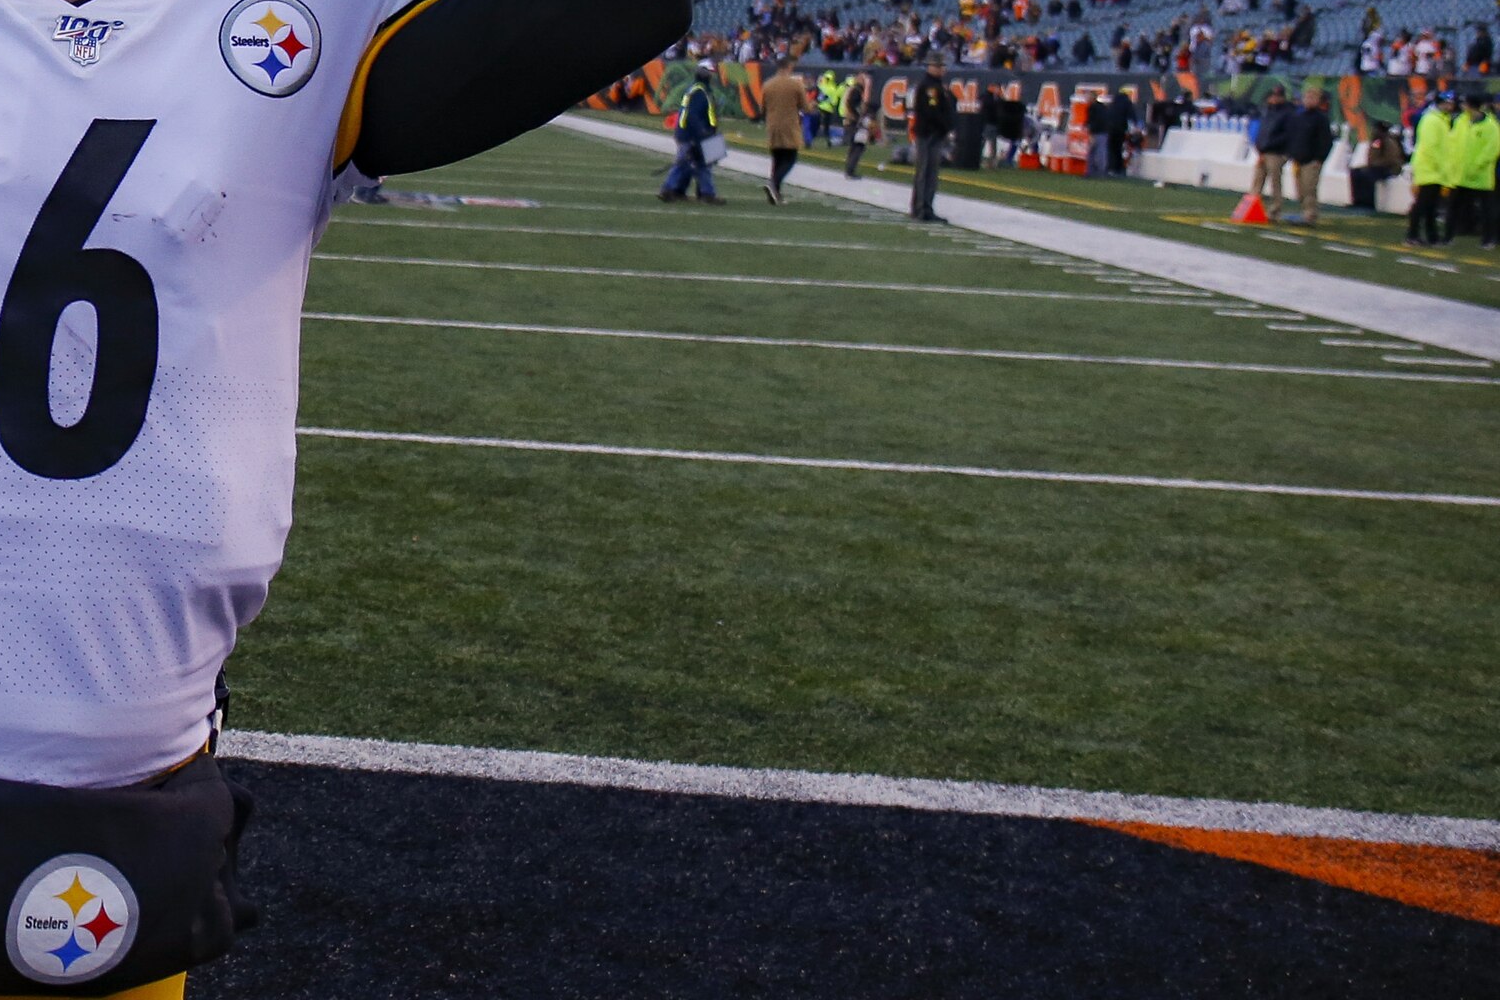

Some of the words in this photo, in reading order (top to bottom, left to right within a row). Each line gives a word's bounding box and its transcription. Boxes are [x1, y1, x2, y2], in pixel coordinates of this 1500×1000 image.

[231, 35, 270, 48] Steelers
[75, 44, 95, 59] NFL
[25, 915, 68, 930] Steelers
